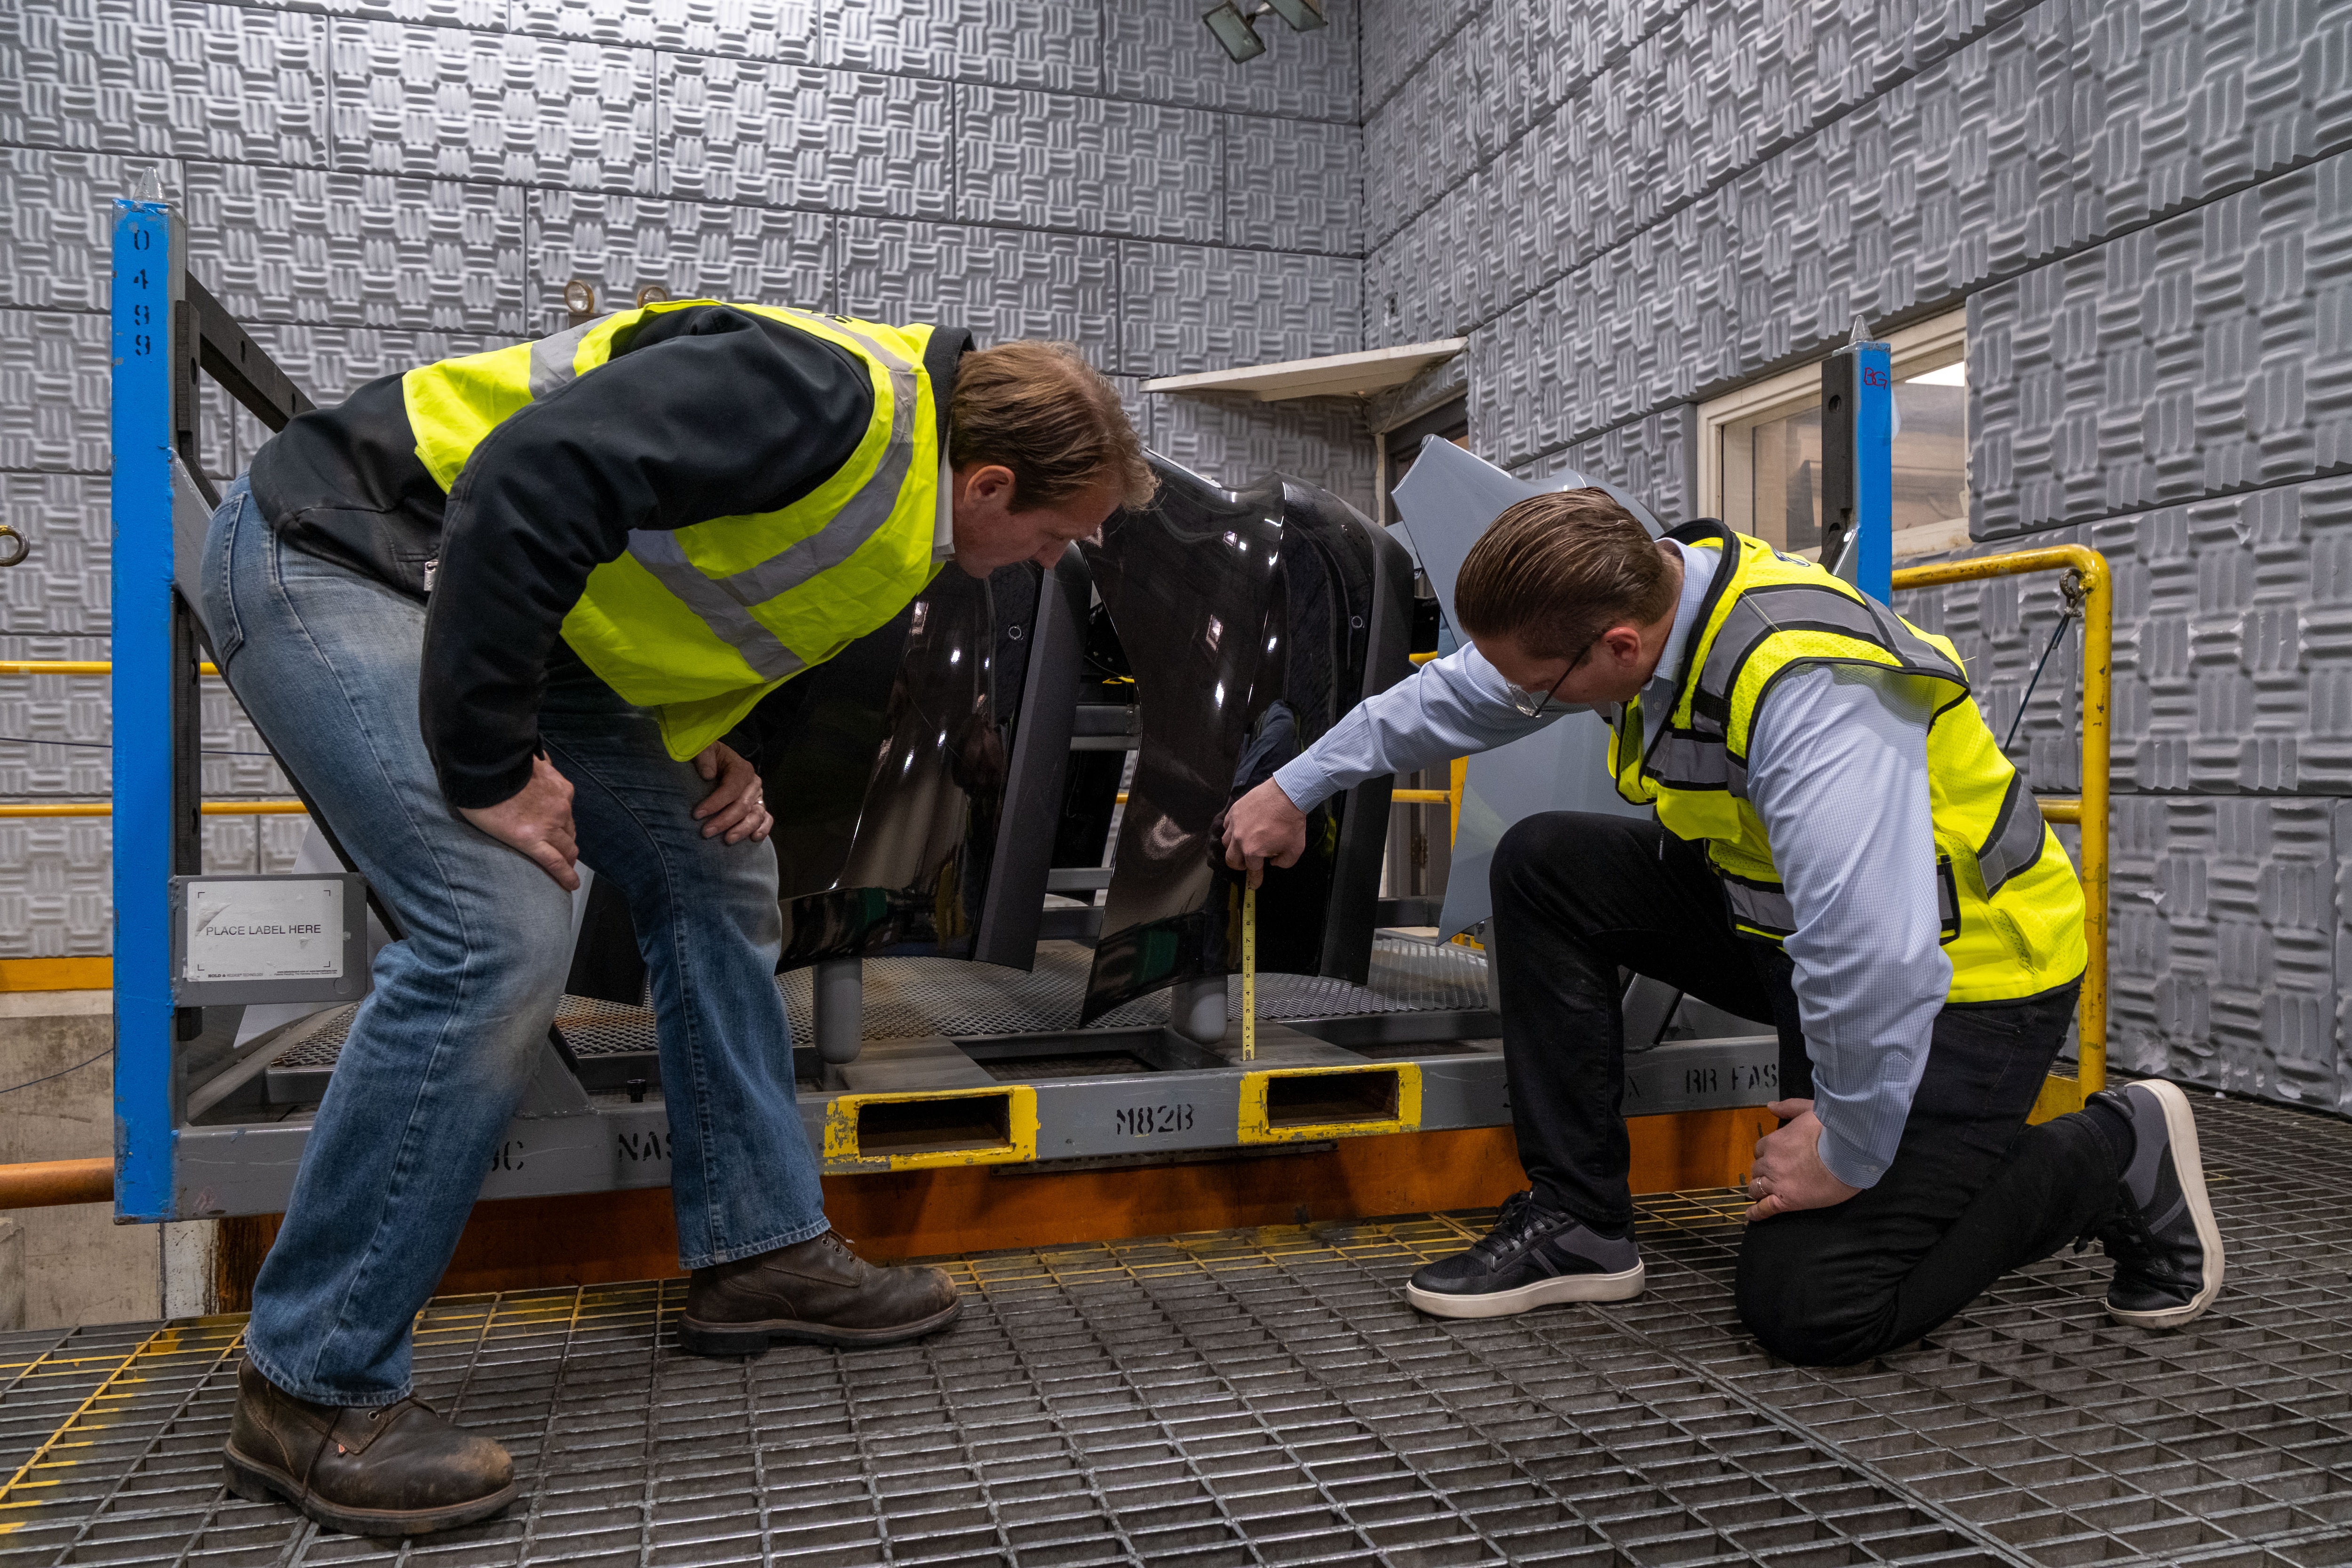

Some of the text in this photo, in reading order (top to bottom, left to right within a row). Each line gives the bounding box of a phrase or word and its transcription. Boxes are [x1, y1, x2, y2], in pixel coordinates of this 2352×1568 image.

[1864, 367, 1887, 390] BG
[206, 924, 321, 935] PLACE LABEL HERE
